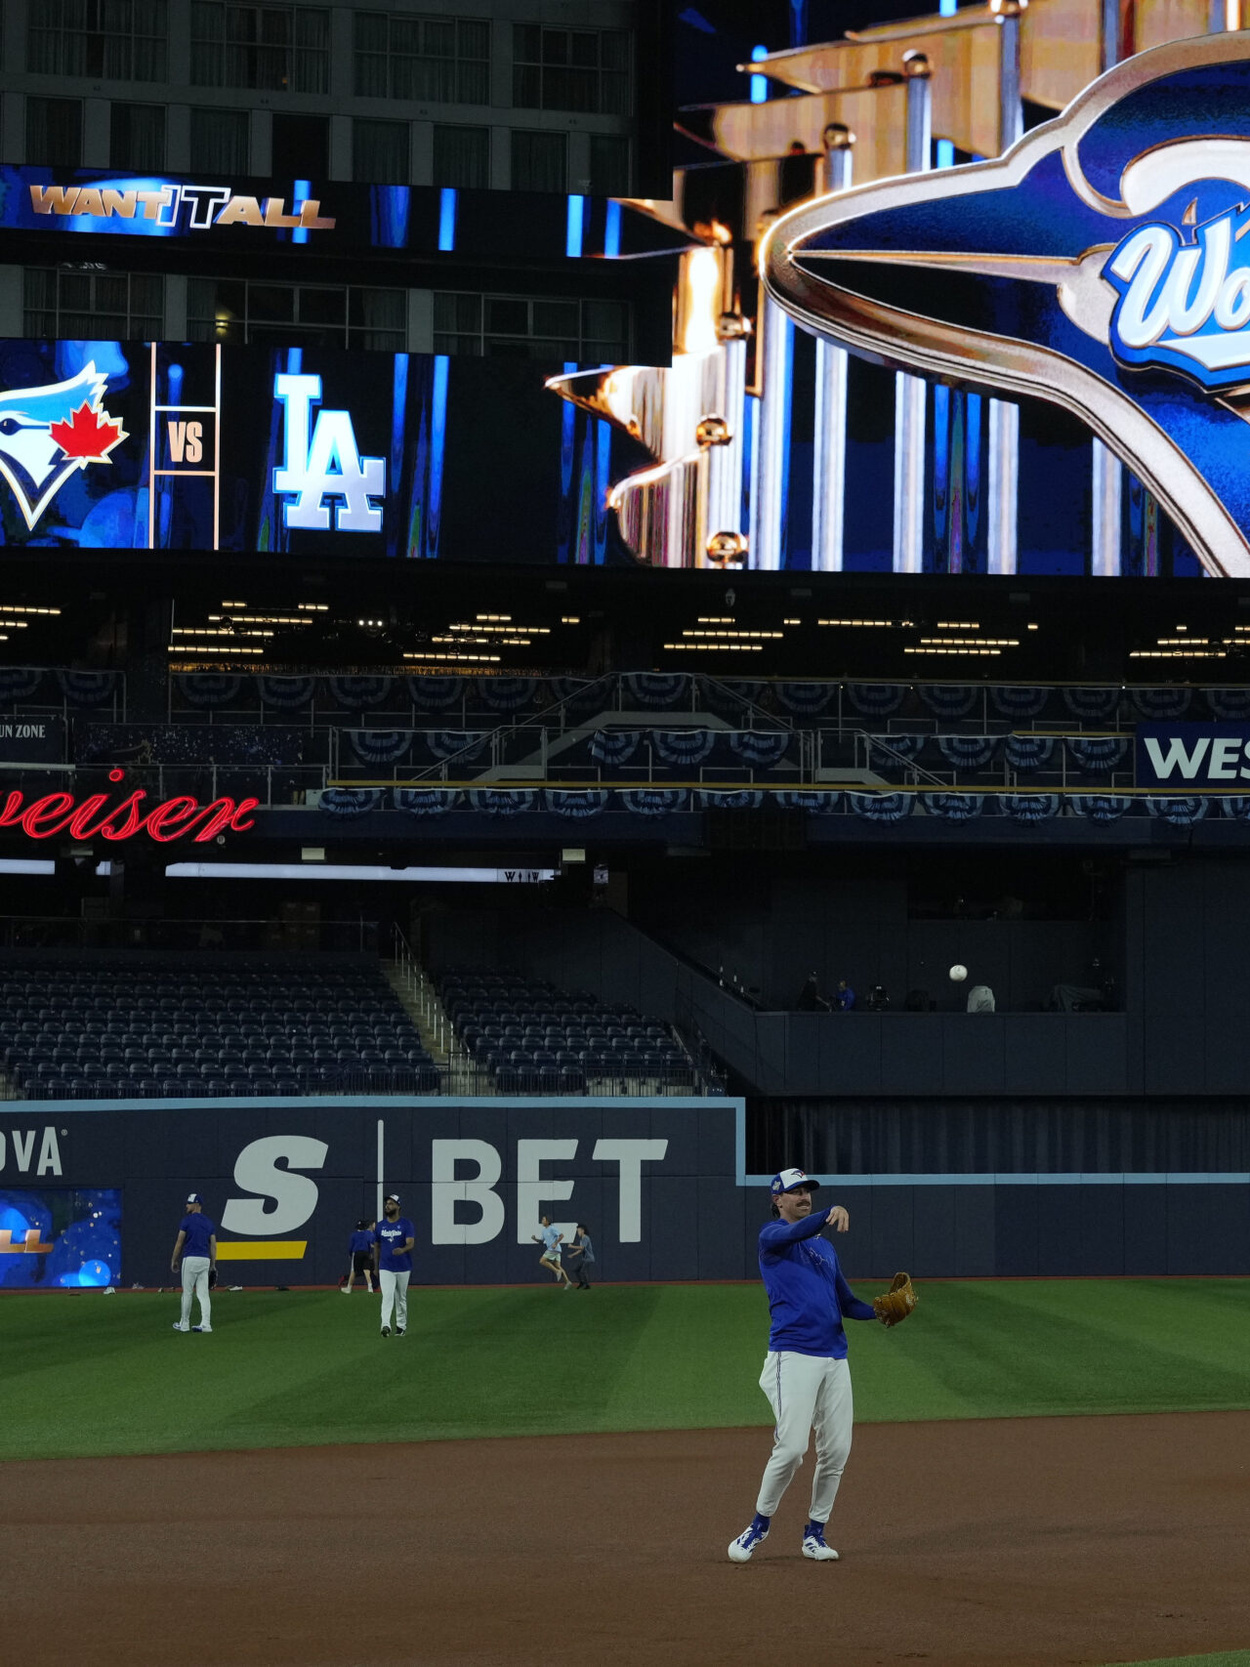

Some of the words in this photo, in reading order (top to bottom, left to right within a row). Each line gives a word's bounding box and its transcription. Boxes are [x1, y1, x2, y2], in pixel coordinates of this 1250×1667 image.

[30, 185, 172, 220] WANT
[214, 195, 337, 230] ALL
[168, 421, 203, 463] VS
[272, 373, 386, 533] LA
[15, 724, 46, 739] ZONE
[221, 1135, 328, 1236] S
[431, 1138, 668, 1245] BET
